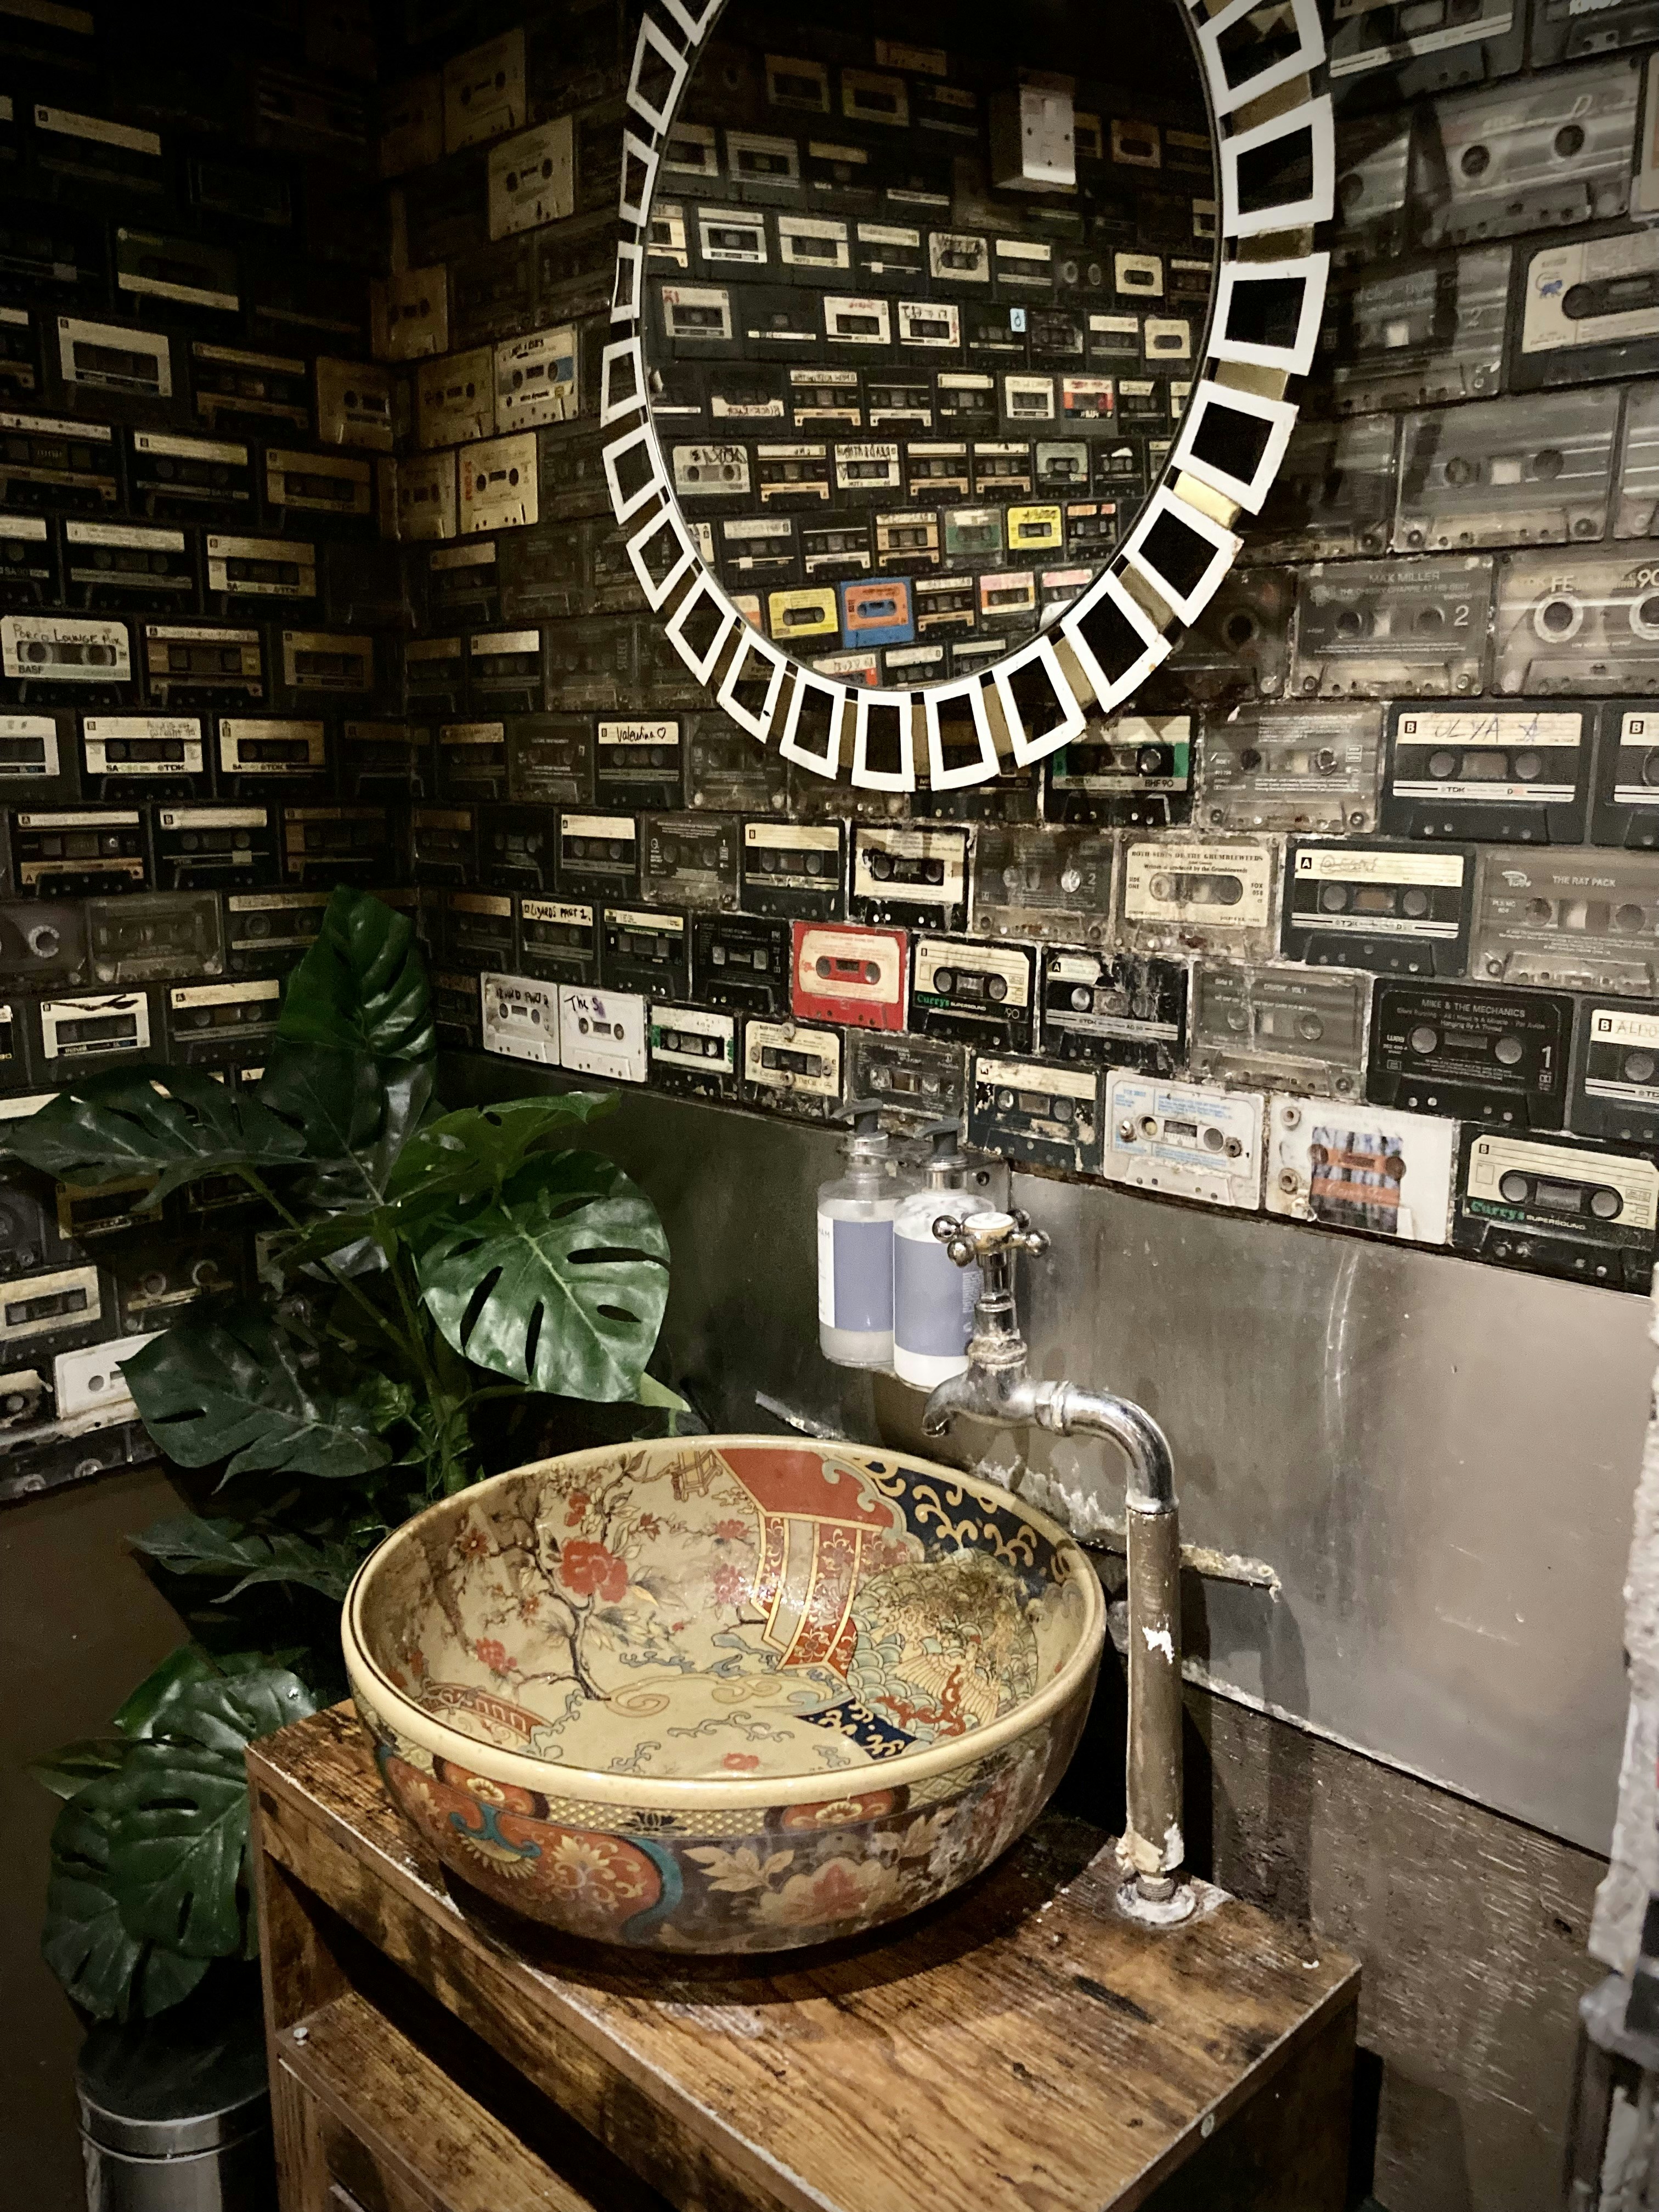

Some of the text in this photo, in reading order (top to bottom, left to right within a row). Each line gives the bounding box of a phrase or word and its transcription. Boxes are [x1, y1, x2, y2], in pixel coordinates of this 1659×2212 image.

[1369, 571, 1440, 583] MAX MILLER
[1551, 575, 1575, 592] FE
[1454, 605, 1470, 627] 2
[1144, 778, 1161, 788] BHF
[1163, 779, 1174, 788] 90
[1088, 873, 1097, 886] 2
[1552, 875, 1616, 888] THE RAT PACK
[563, 995, 589, 1011] The
[916, 992, 950, 1008] Currys
[1421, 999, 1526, 1018] MIKE & THE MECHANICS
[1541, 1046, 1552, 1069] 1
[947, 1084, 955, 1095] 2
[1471, 1200, 1587, 1231] Currys SUPERSOUND
